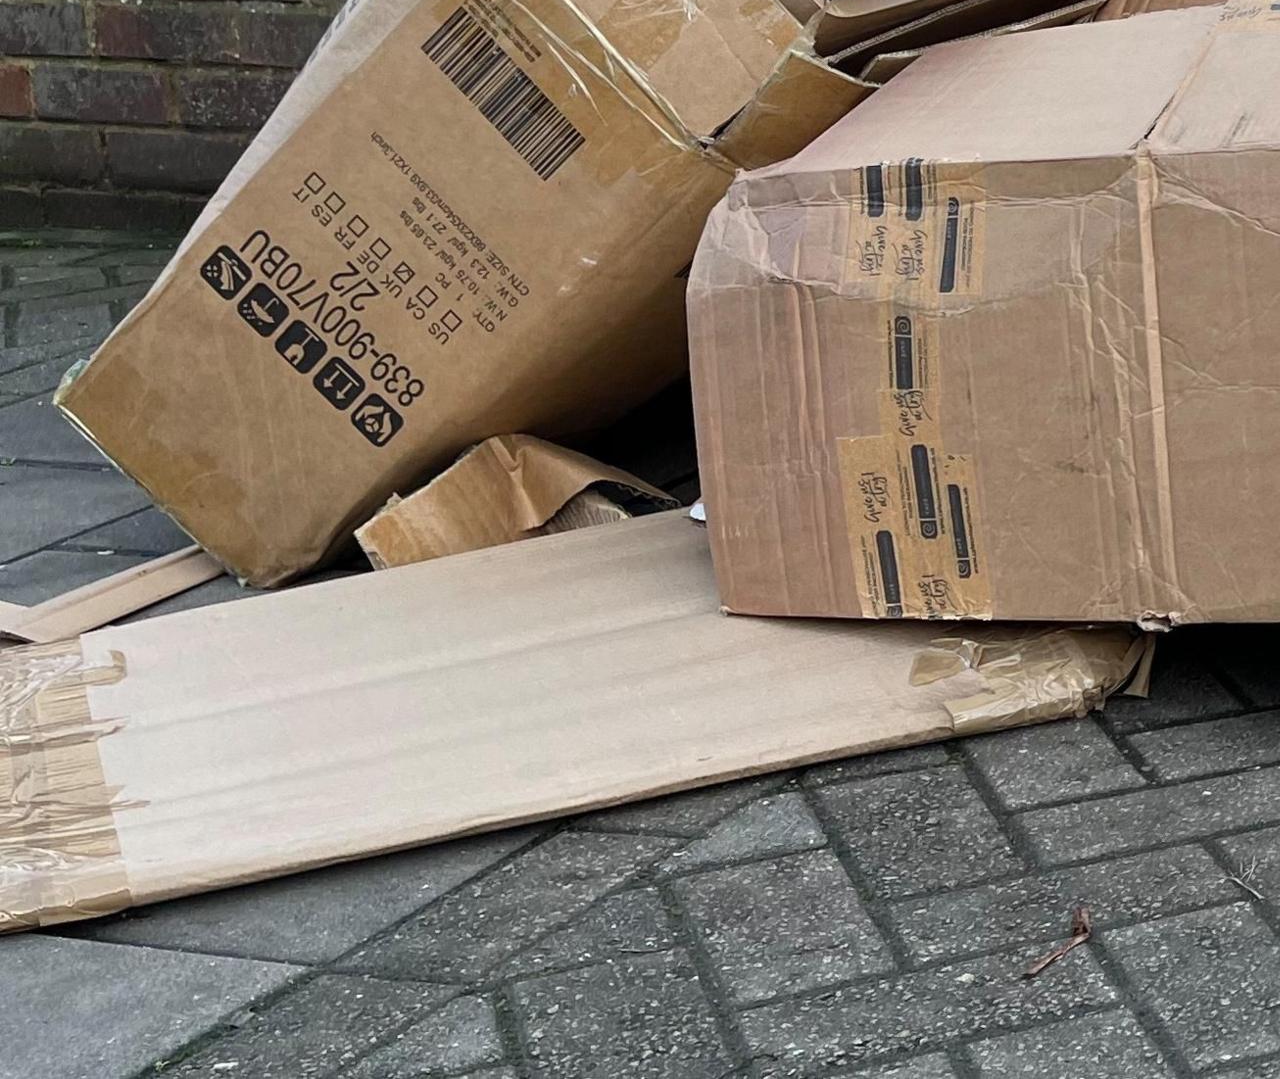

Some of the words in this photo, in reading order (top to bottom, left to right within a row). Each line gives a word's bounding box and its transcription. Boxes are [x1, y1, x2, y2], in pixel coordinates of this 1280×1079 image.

[291, 184, 310, 204] IT
[309, 202, 333, 226] ES
[423, 211, 448, 235] 27.1
[332, 225, 357, 250] FR
[355, 248, 381, 274] DE
[468, 256, 492, 280] 12.3
[483, 248, 511, 276] SIZE:
[325, 259, 381, 315] 2/2
[378, 272, 404, 298] UK
[433, 270, 452, 289] PC
[454, 267, 482, 296] 10.75
[505, 271, 531, 297] CTN
[238, 225, 427, 408] 839-900V70BU
[401, 295, 428, 321] CA
[469, 306, 497, 334] QTY:
[426, 319, 451, 345] US
